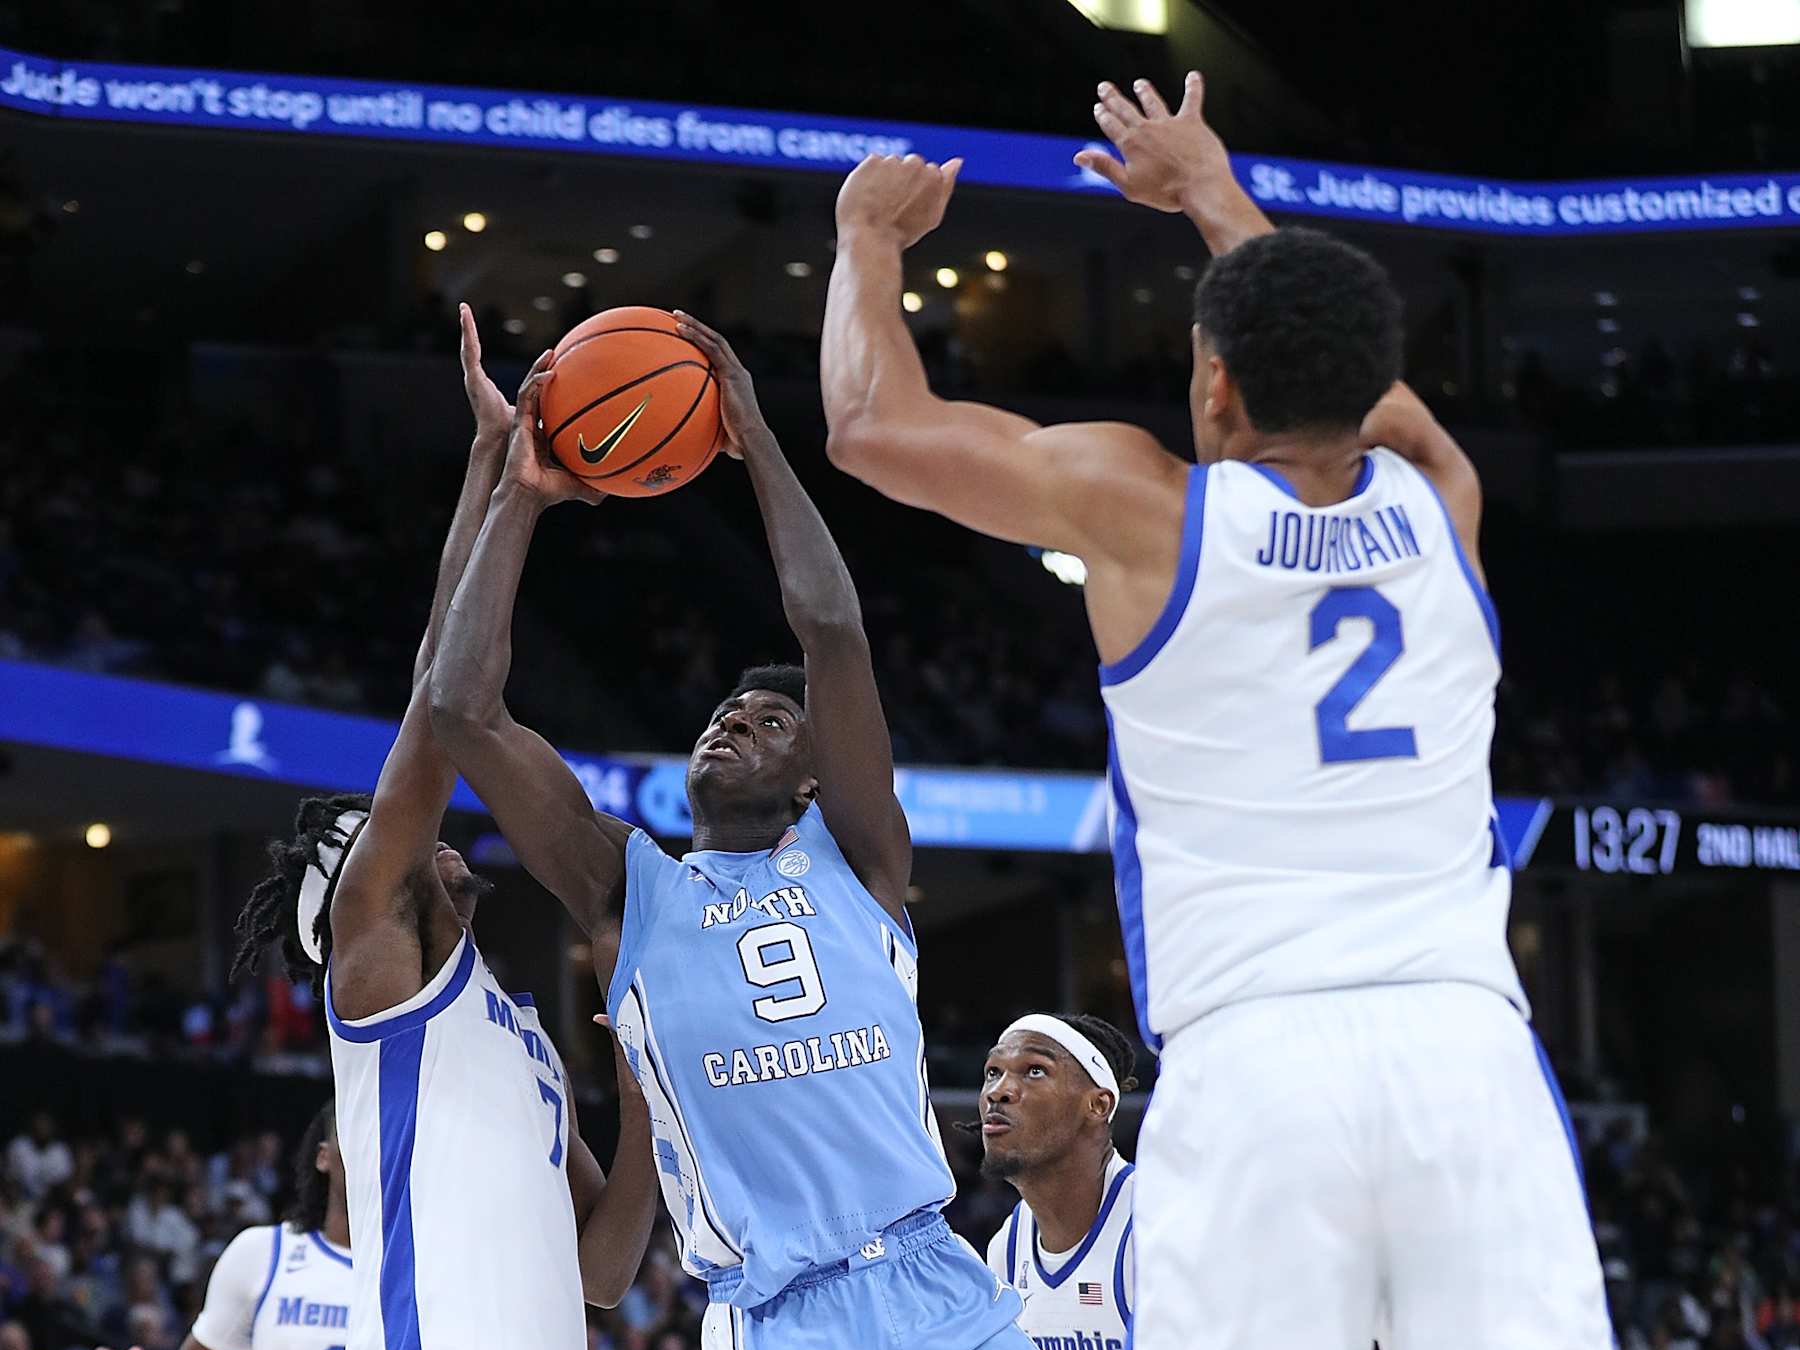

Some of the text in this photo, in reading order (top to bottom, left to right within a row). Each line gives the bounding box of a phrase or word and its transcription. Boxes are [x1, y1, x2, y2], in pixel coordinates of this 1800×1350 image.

[0, 62, 99, 108] Jude
[103, 79, 225, 115] won't
[227, 83, 325, 131] stop
[326, 89, 424, 130] until
[427, 101, 483, 134] no
[485, 99, 587, 142] child
[588, 106, 674, 149] dies
[675, 110, 777, 157] from
[1305, 169, 1399, 213] Jude
[1401, 183, 1555, 226] provides
[1558, 180, 1782, 226] customized
[1257, 504, 1422, 573] JOURDAIN
[1307, 585, 1419, 765] 2
[1574, 806, 1681, 874] 13:27
[1697, 823, 1753, 867] 2ND
[701, 887, 817, 929] NOTH
[736, 921, 827, 1023] 9
[703, 1024, 891, 1087] CAROLINA
[536, 1074, 564, 1168] 7
